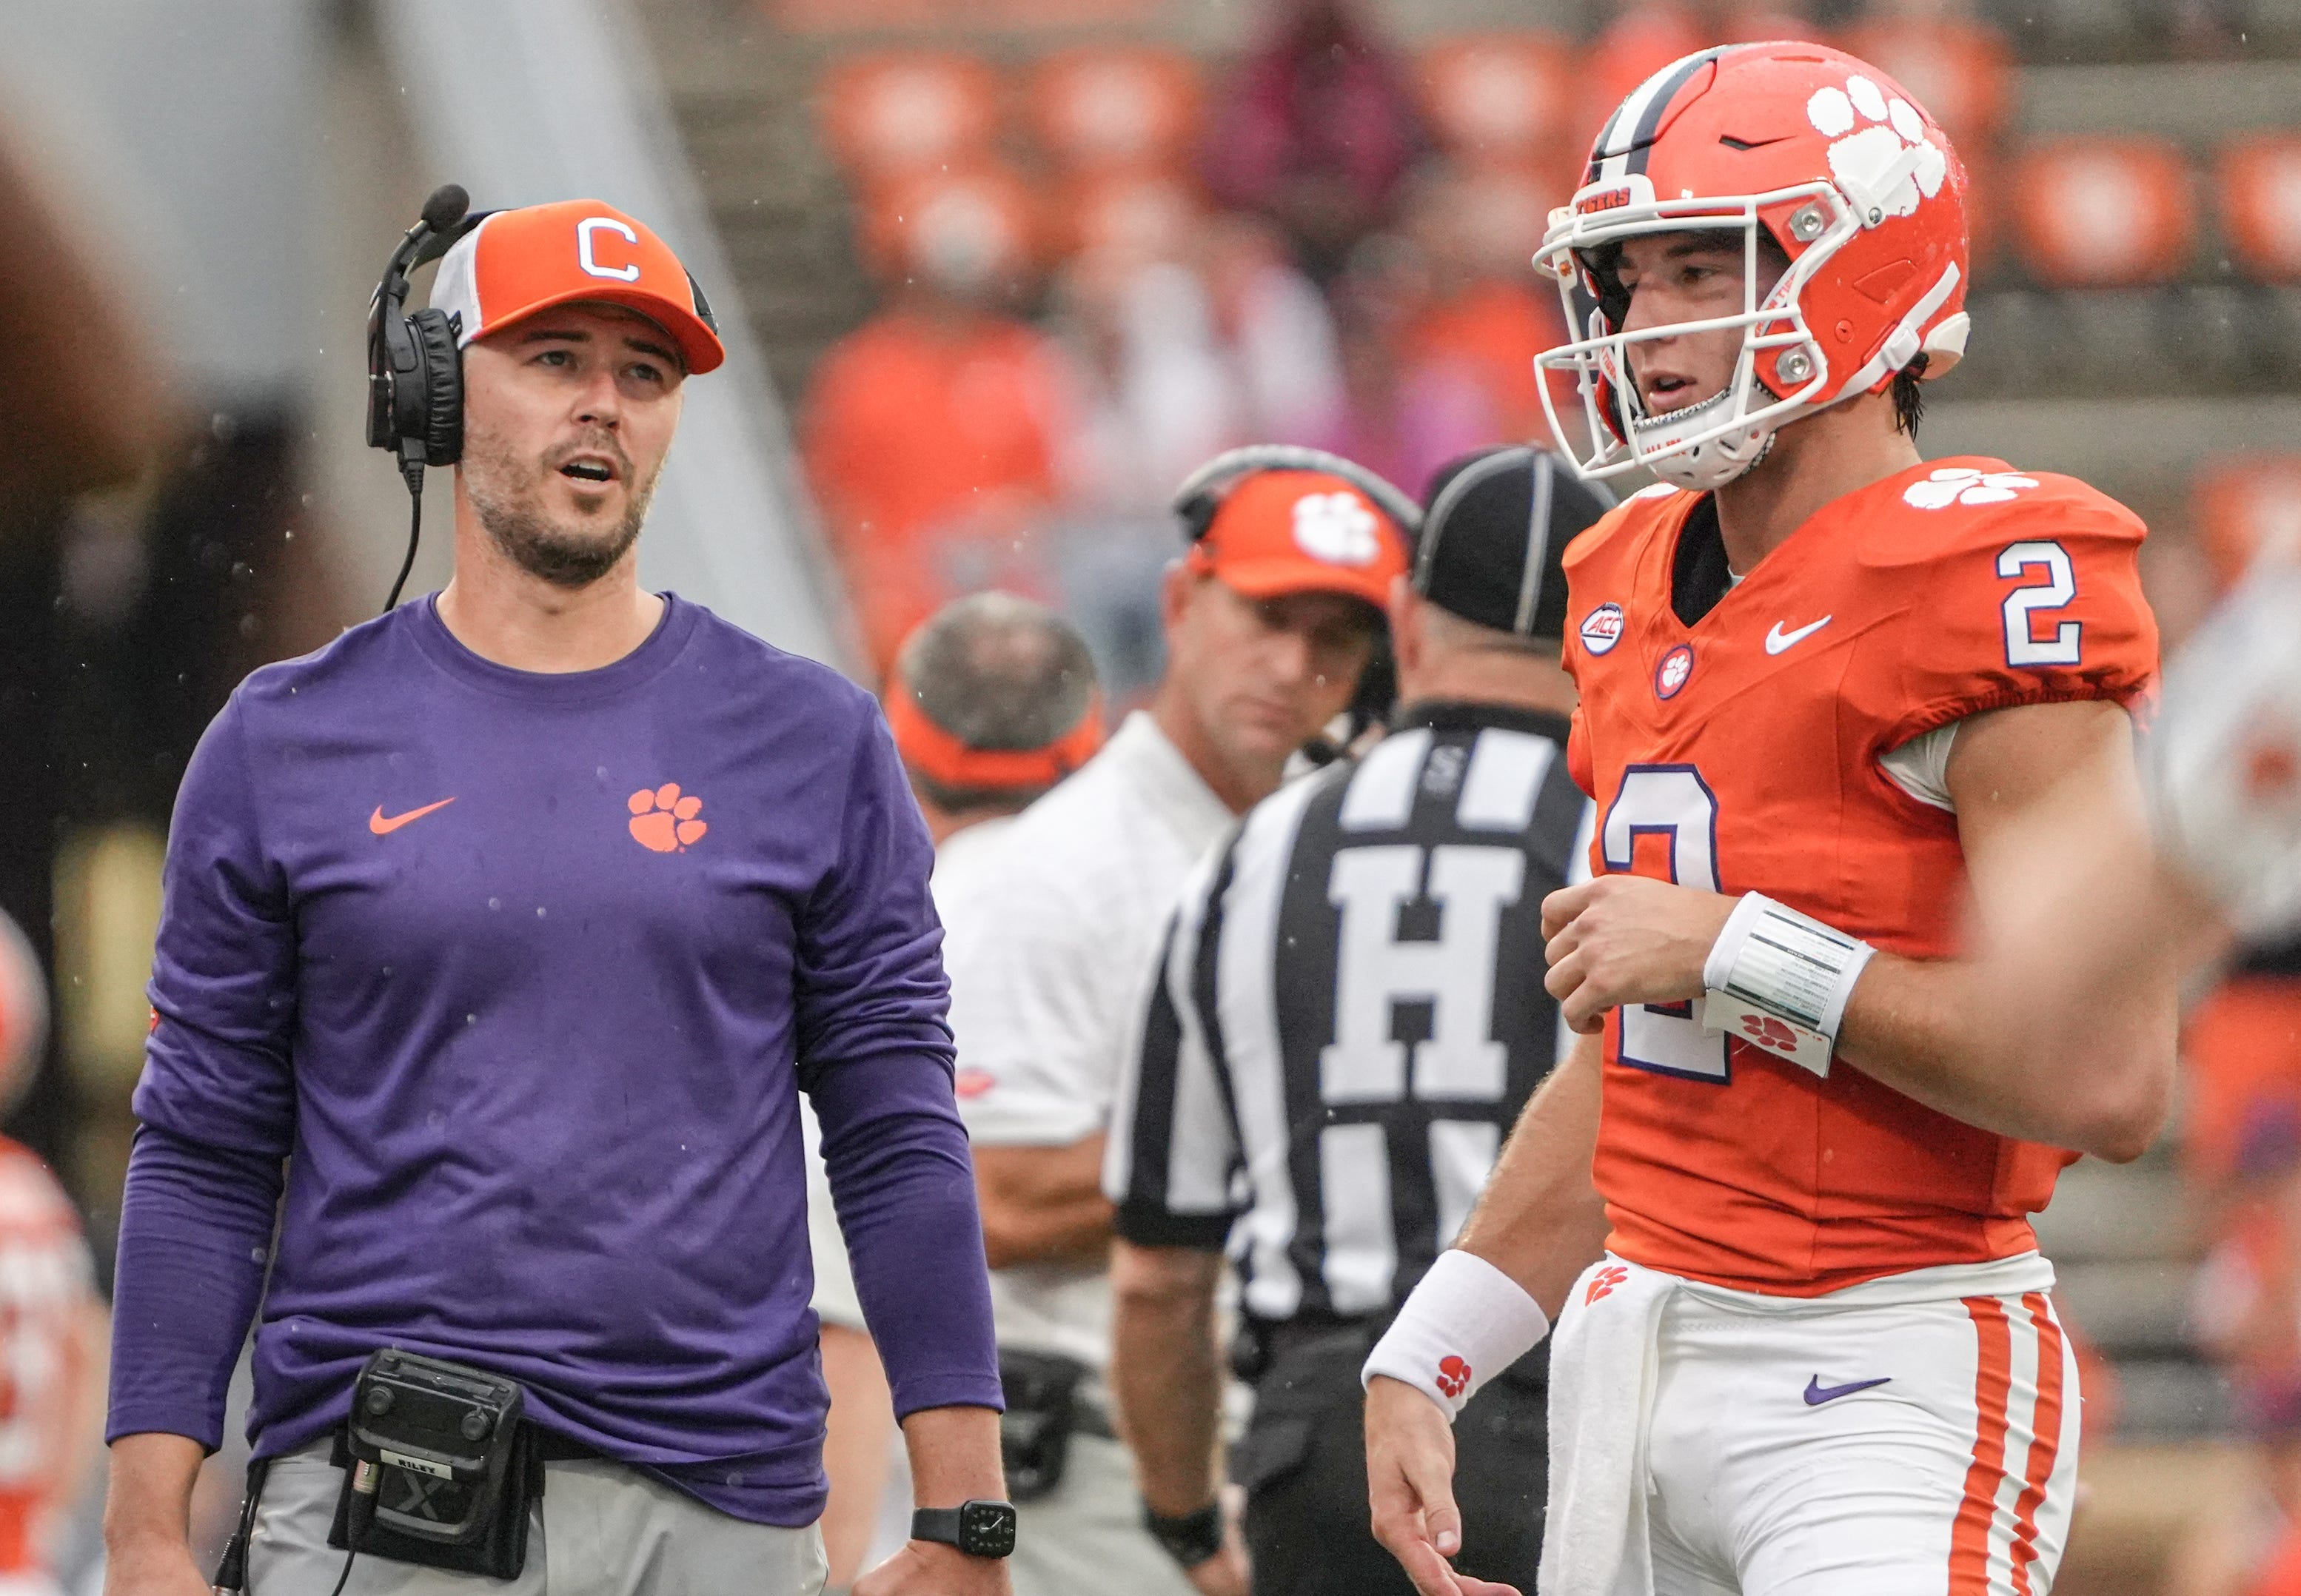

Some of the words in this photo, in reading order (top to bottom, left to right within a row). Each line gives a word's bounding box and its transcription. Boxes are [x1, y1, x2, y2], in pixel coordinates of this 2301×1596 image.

[1576, 187, 1630, 215] TIGERS
[576, 217, 640, 282] C
[1587, 616, 1620, 634] ACC
[1995, 540, 2083, 668] 2
[1318, 844, 1527, 1103] H
[398, 1459, 435, 1474] RILEY
